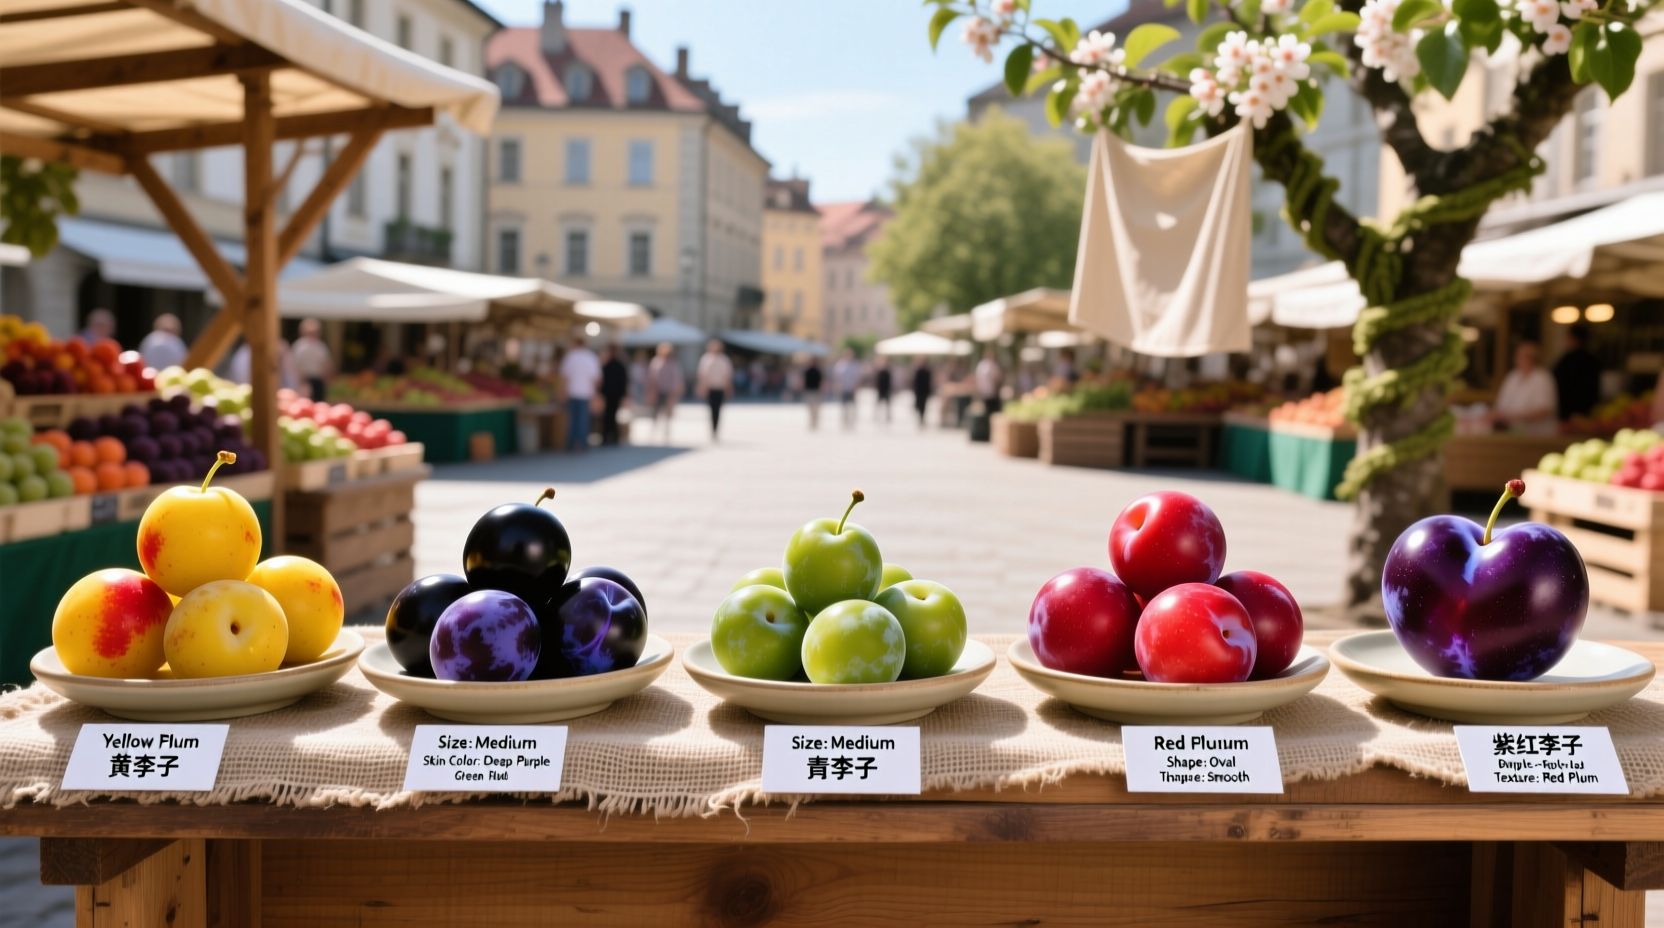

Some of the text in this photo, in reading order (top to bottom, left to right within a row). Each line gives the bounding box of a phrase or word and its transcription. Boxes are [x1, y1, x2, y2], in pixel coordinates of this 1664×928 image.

[103, 733, 154, 749] Yellow
[438, 735, 537, 750] Size: Medium
[792, 735, 895, 750] Size: Medium
[1154, 735, 1186, 750] Red
[1493, 733, 1583, 756] 紫红李子
[108, 753, 179, 778] 黄李子
[423, 754, 551, 769] Skin Color: Deep Purple
[807, 755, 878, 780] 青李子
[1167, 756, 1236, 770] Shape: Oval
[1494, 771, 1599, 784] Texture: Red Plum
